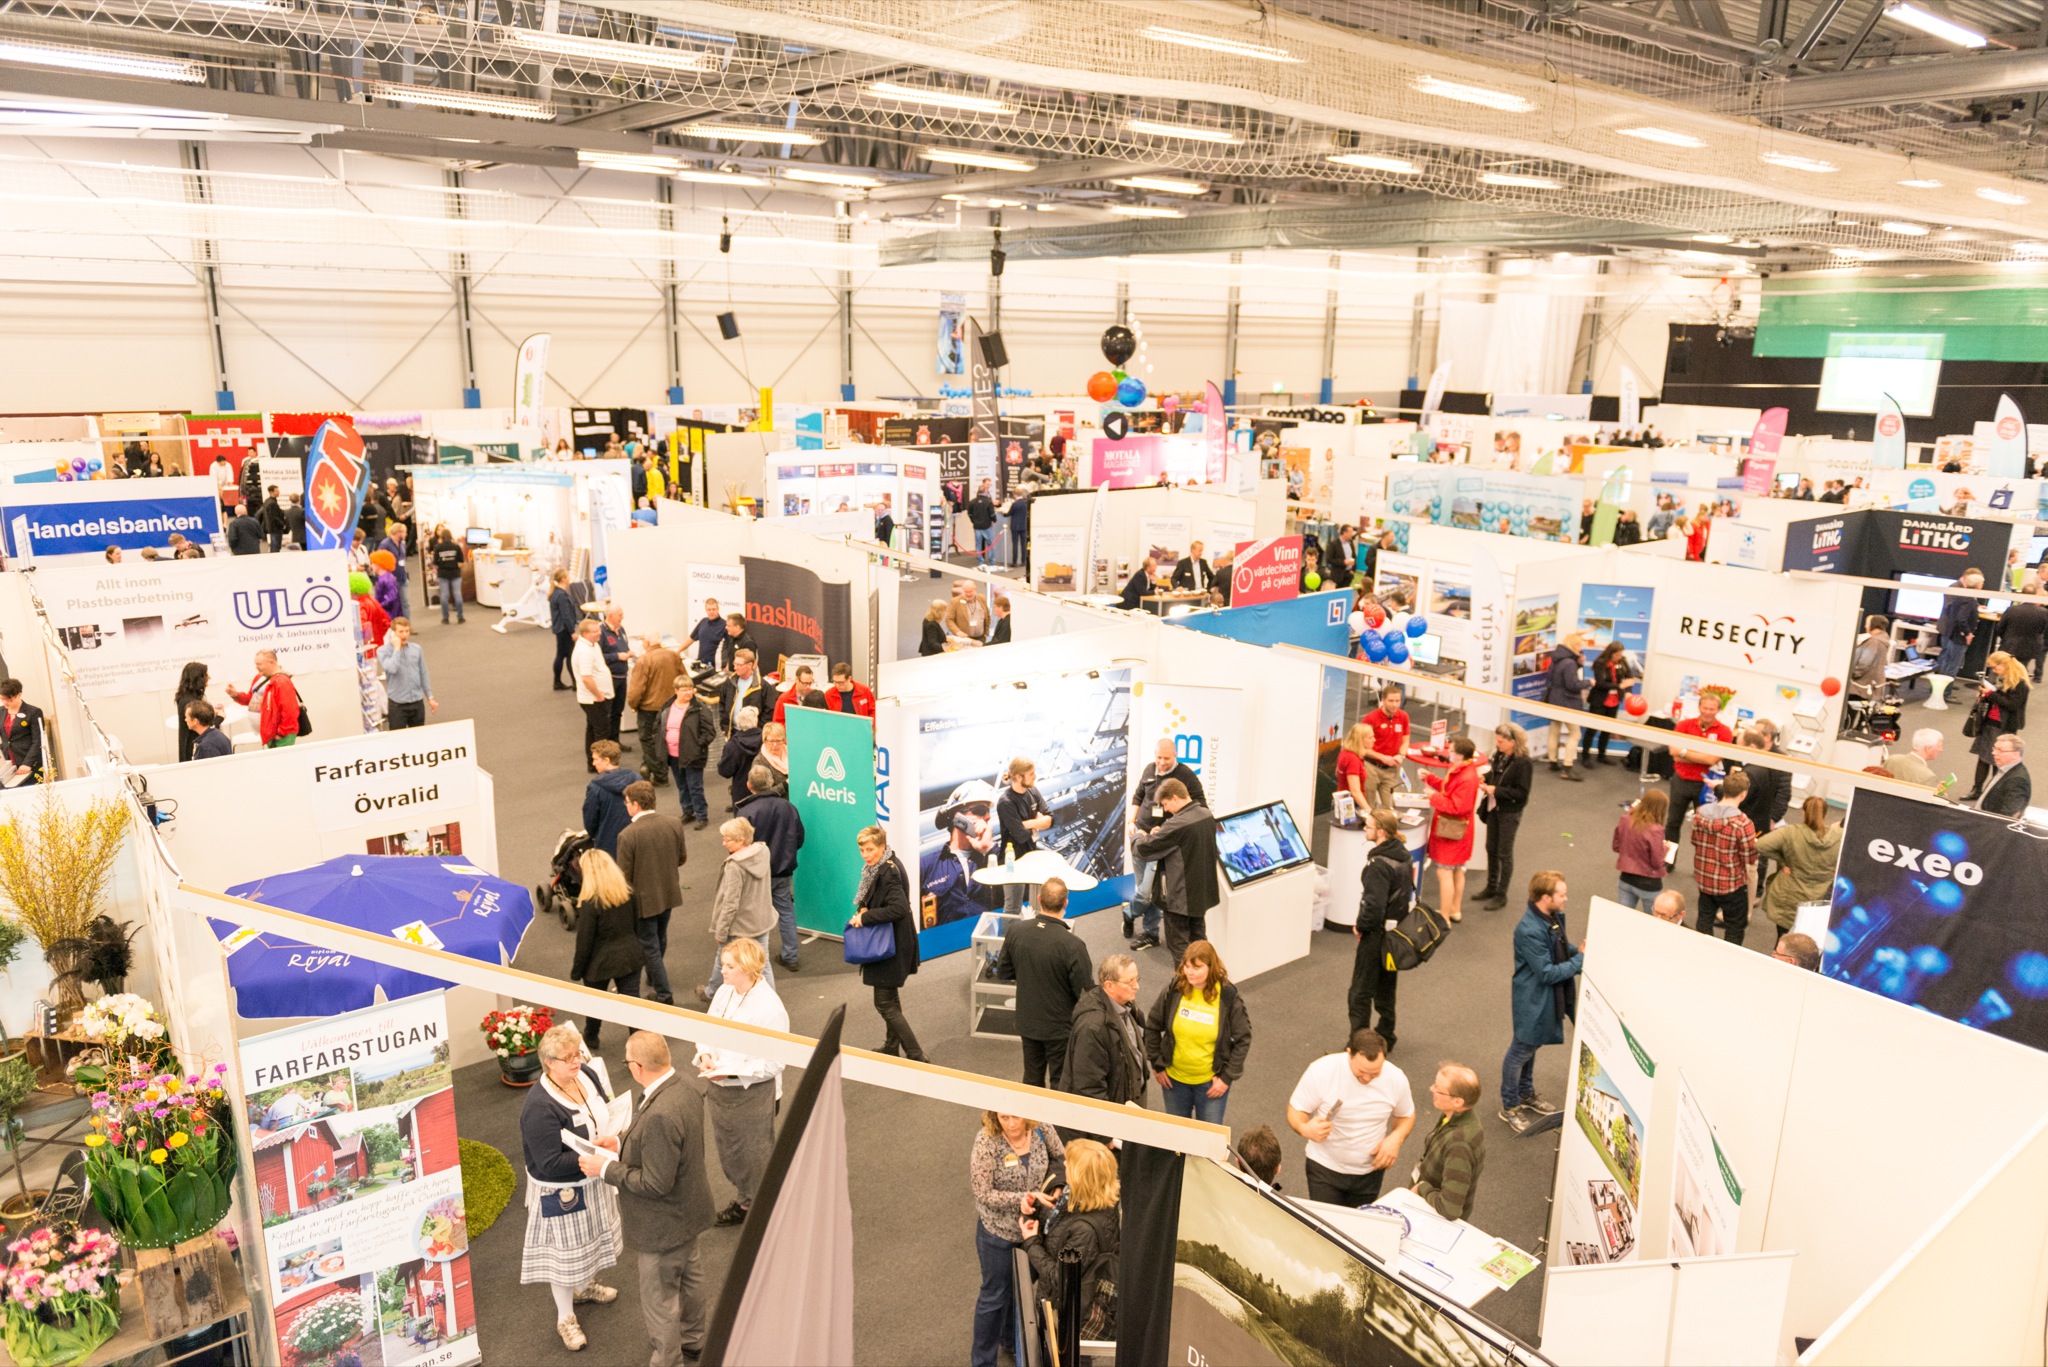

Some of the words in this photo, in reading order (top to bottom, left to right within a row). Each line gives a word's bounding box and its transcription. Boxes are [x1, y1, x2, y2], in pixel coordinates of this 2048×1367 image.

[939, 449, 968, 470] NES
[1104, 450, 1141, 460] MOTALA
[28, 513, 203, 540] Handelsbanken
[1814, 518, 1845, 533] DANAGÅRD
[1902, 518, 1974, 534] DANAGÅRD
[1273, 546, 1299, 562] Vinn
[1253, 561, 1298, 577] värdecheck
[95, 577, 122, 591] Allt
[125, 577, 162, 589] inom
[1261, 578, 1272, 591] på
[1273, 573, 1297, 588] cykel!
[66, 590, 194, 611] Plastbearbetning
[238, 632, 274, 644] Display
[276, 631, 284, 639] &
[286, 625, 347, 639] Industriplast
[1680, 616, 1805, 654] RESECITY
[272, 641, 331, 655] ww.ulo.se
[315, 743, 467, 783] Farfarstugan
[1208, 736, 1219, 812] ENTILSERVICE
[354, 783, 440, 816] Övralid
[806, 781, 857, 806] Aleris
[1867, 837, 1984, 887] exeo
[473, 888, 501, 919] Royal
[287, 952, 352, 974] Royal
[301, 1027, 374, 1052] Välkommen
[378, 1018, 396, 1033] till
[255, 1022, 437, 1087] FARFARSTUGAN
[271, 1222, 306, 1241] Koppla
[309, 1219, 321, 1229] av
[324, 1211, 343, 1224] med
[346, 1207, 358, 1217] en
[360, 1198, 383, 1215] kopp
[385, 1189, 409, 1206] kaffe
[413, 1182, 429, 1195] och
[309, 1225, 331, 1241] bröd
[340, 1203, 401, 1232] Farfarstugan
